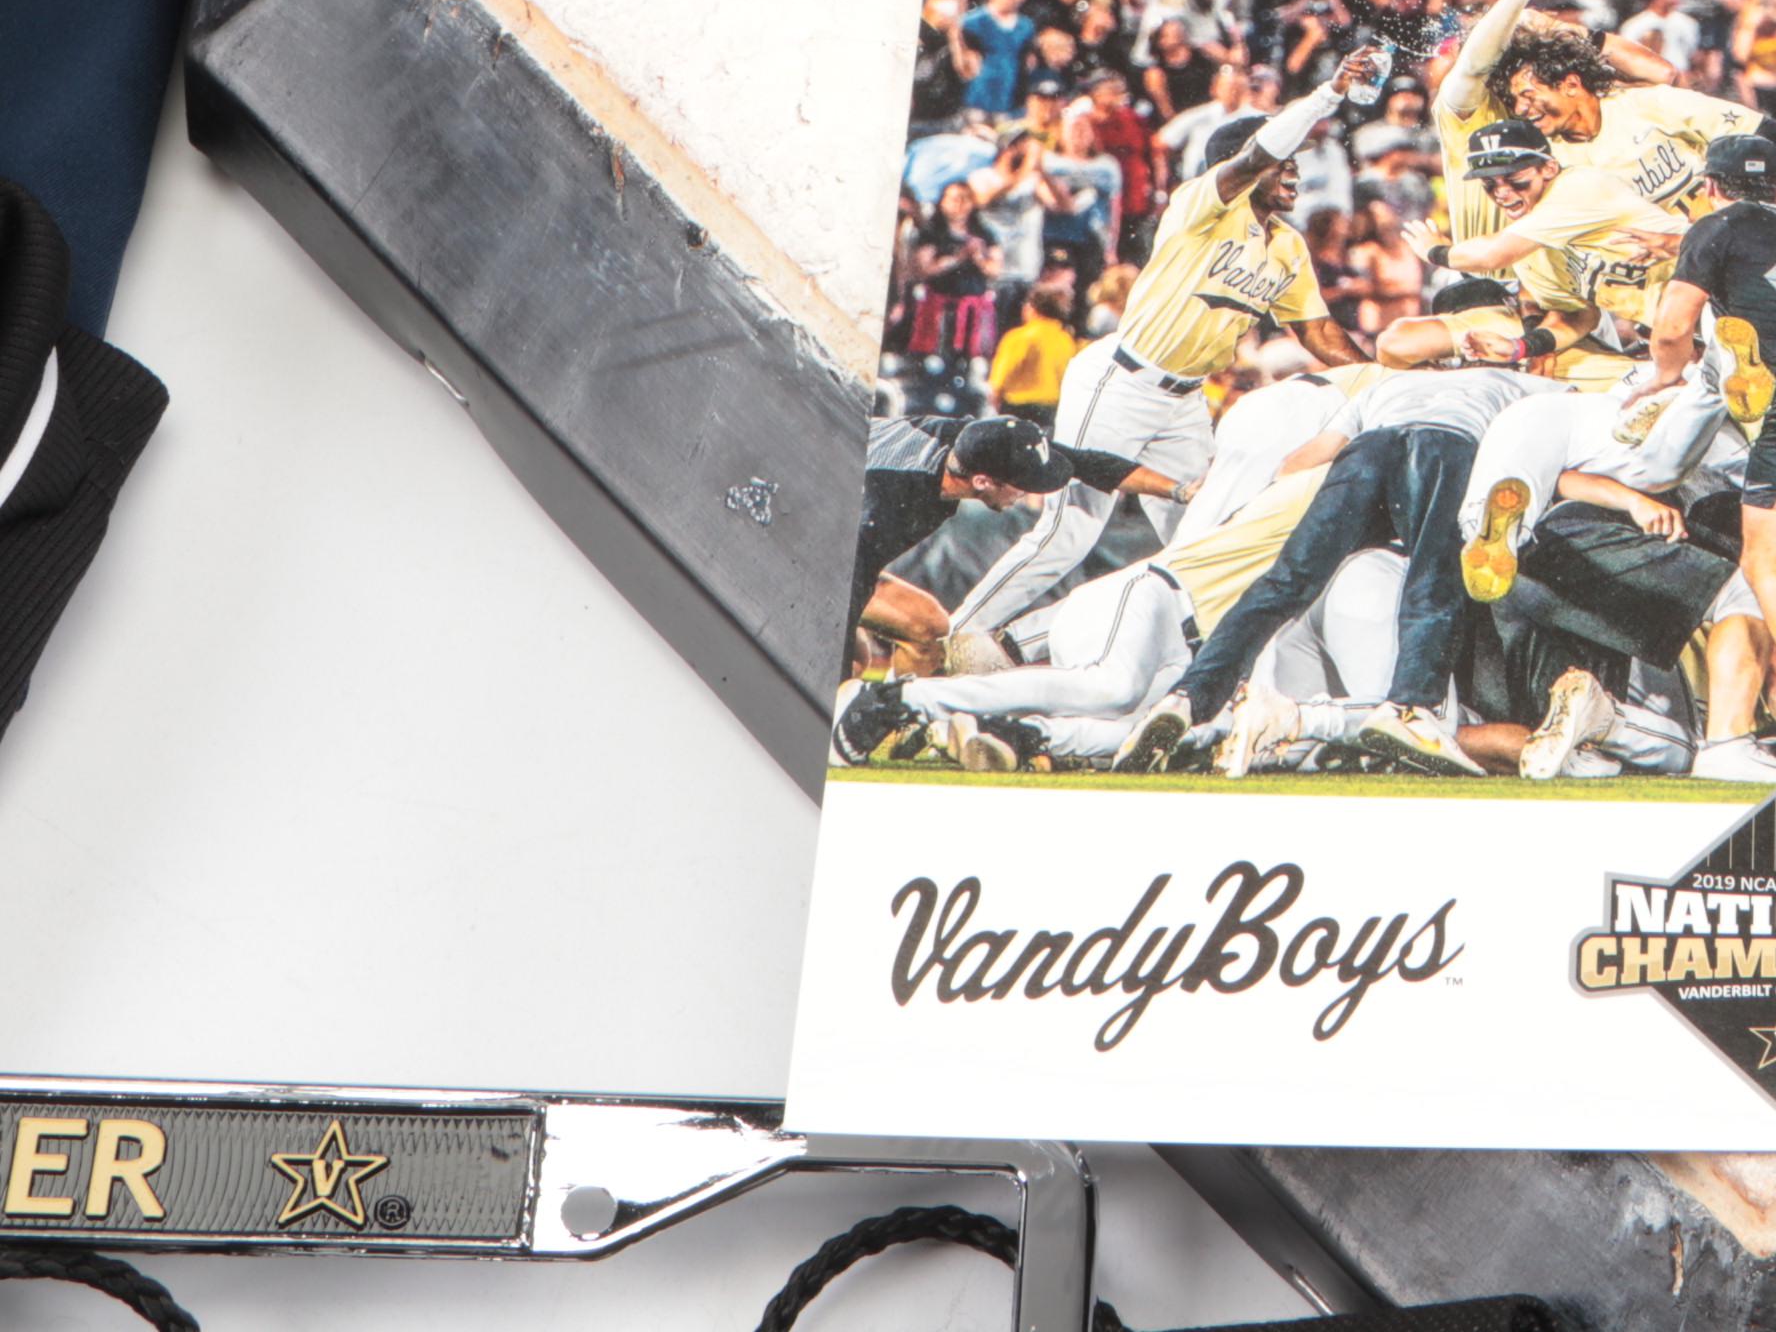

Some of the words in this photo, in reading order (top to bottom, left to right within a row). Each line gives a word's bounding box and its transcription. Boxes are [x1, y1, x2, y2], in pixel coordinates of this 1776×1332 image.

[1692, 873, 1736, 890] 2019
[890, 860, 1466, 1053] VandyBoys
[1678, 983, 1772, 1001] VANDERBILT
[4, 1117, 167, 1222] ER
